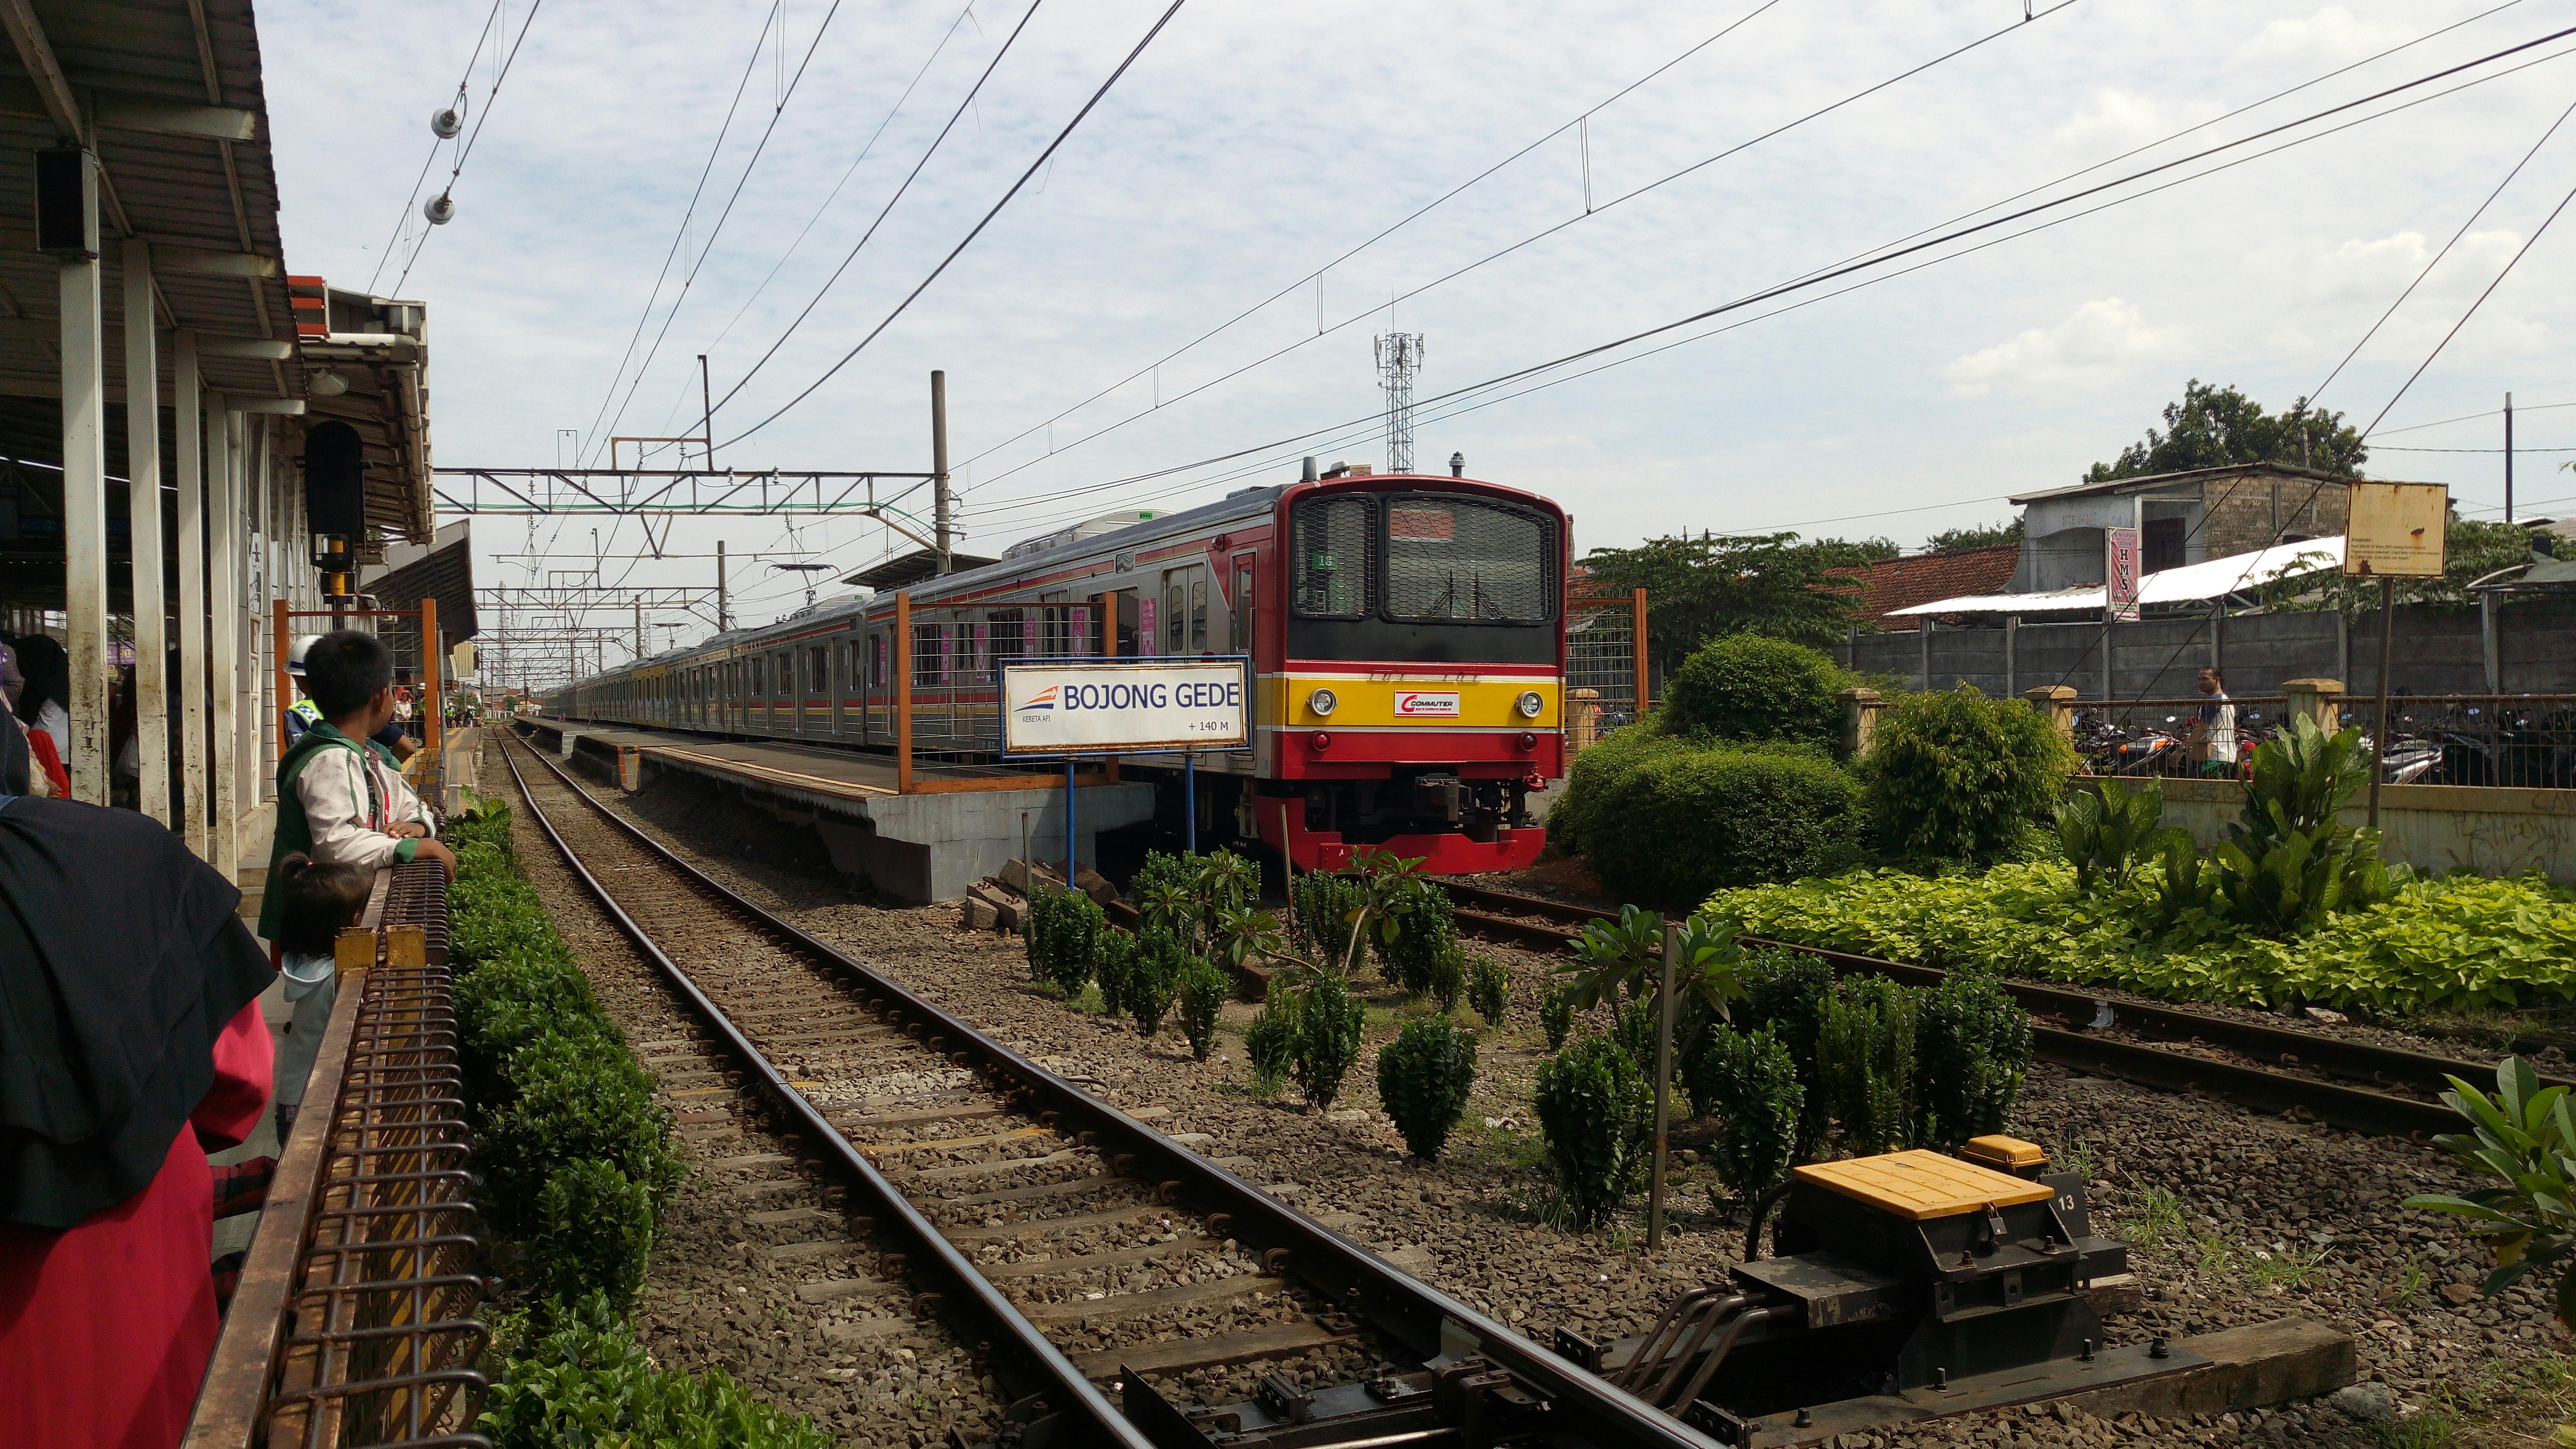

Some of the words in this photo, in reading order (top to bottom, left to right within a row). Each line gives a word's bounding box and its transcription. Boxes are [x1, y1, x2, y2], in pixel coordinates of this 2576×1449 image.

[1064, 683, 1167, 710] BOJONG
[1175, 683, 1239, 708] GEDE
[1200, 721, 1217, 730] 140
[1220, 722, 1228, 730] M
[2058, 1195, 2075, 1210] 13
